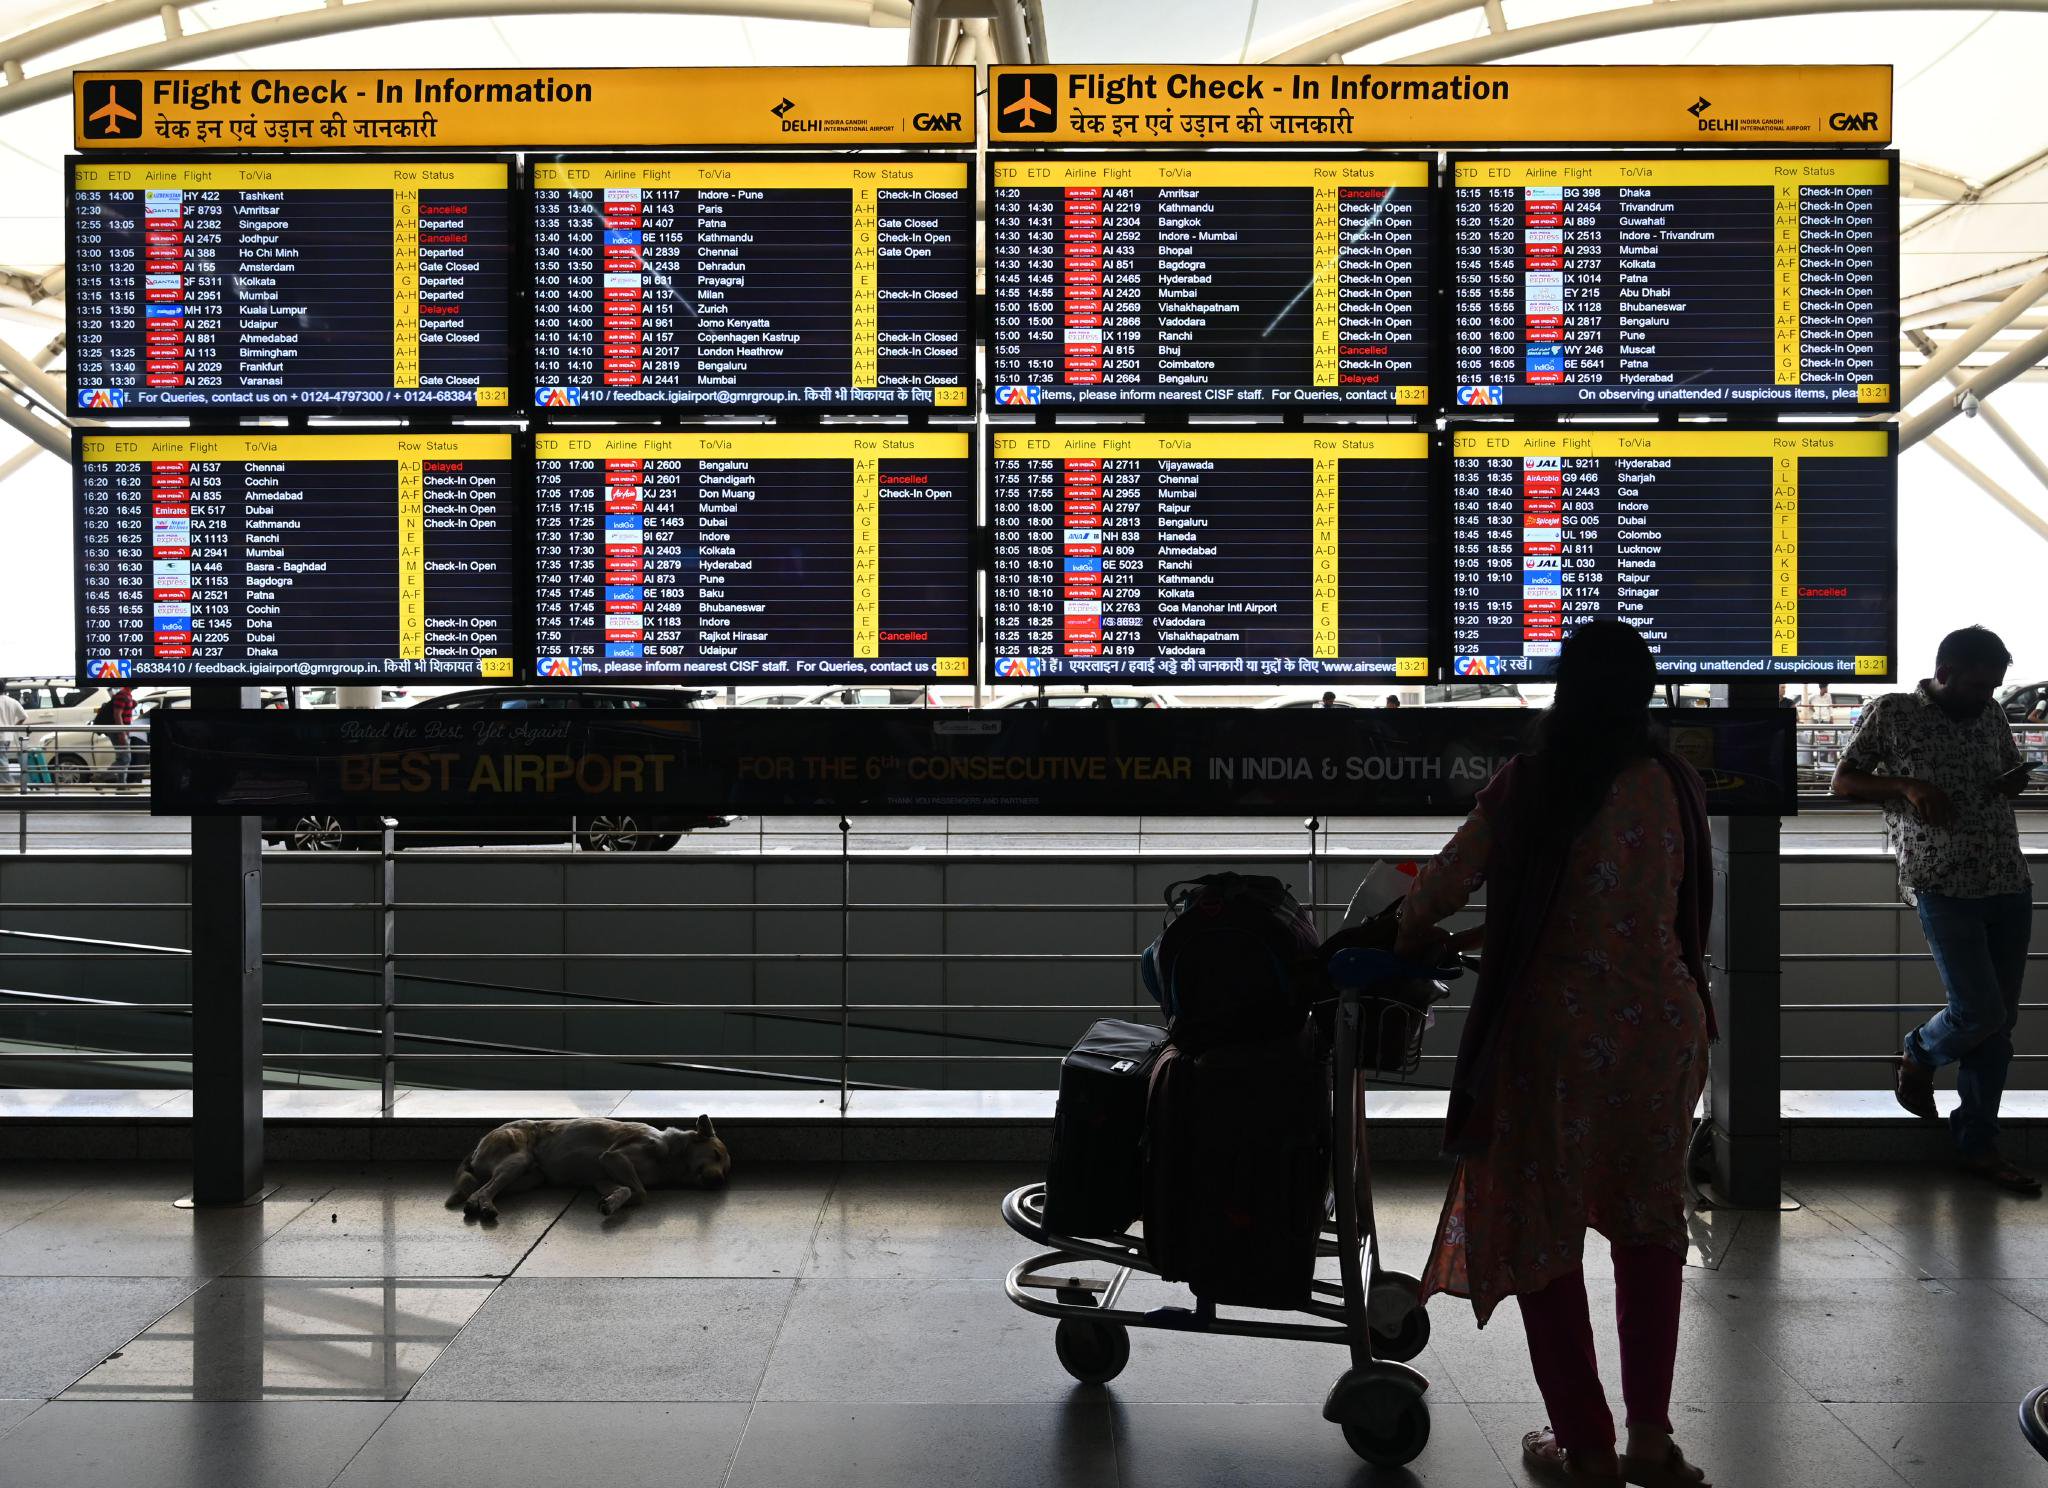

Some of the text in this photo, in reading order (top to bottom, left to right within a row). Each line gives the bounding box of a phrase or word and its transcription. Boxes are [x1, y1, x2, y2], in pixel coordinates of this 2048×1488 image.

[154, 80, 241, 110] Flight
[251, 79, 347, 104] Check
[377, 79, 402, 103] In
[415, 77, 591, 103] Information
[1069, 74, 1157, 104] Flight
[1167, 74, 1263, 99] Check
[1293, 75, 1319, 99] In
[1332, 74, 1508, 100] Information
[155, 111, 438, 143] चेक इन एवं उड़ान की जानकारी
[782, 120, 822, 132] DELHI
[1070, 107, 1354, 138] चेक इन एवं उड़ान की जानकारी
[1699, 119, 1738, 131] DELHI
[75, 170, 454, 182] STD ETD Airline Flight To/Via Row Status
[76, 191, 416, 200] 06:35 14:00 HY 422 Tashkent H-N
[698, 191, 763, 199] Indore Pune
[239, 205, 467, 214] Amritsar Cancelled
[995, 203, 1335, 212] 14:30 14:30 AI 2219 Kathmandu A-H
[1619, 203, 1674, 211] Trivandrum
[240, 306, 307, 318] Kuala Lumpur
[1158, 303, 1411, 314] Vishakhapatnam Check-In Open
[535, 319, 874, 329] 14:00 14:00 AI 961 Jomo Kenyatta A-H
[698, 333, 957, 344] Copenhagen Kastrup Check-In Closed
[1457, 344, 1791, 354] 16:00 16:00 WY 246 Muscat K
[1080, 389, 1234, 402] please inform nearest CISF
[1579, 388, 1791, 401] On observing unattended suspicious
[995, 460, 1334, 471] 17:55 17:55 AI 2711 Vijayawada A-F
[1562, 458, 1572, 468] JL
[1576, 459, 1599, 468] 9211
[1618, 459, 1671, 470] Hyderabad
[699, 475, 927, 486] Chandigarh Cancelled
[1455, 473, 1479, 481] 18:35
[1488, 473, 1512, 481] 18:35
[1562, 473, 1577, 482] G9
[1580, 473, 1598, 482] 466
[1618, 473, 1655, 484] Sharjah
[537, 489, 868, 500] 17:05 17:05 XJ 231 Don Muang J
[117, 506, 141, 514] 16:45
[191, 506, 205, 514] EK
[208, 506, 225, 514] 517
[246, 506, 273, 514] Dubai
[401, 505, 420, 513] J-M
[247, 561, 496, 573] Basra Baghdad Check-In Open
[247, 577, 292, 587] Bagdogra
[1618, 587, 1847, 598] Srinagar Cancelled
[1158, 603, 1277, 614] Goa Manohar Intl Airport
[700, 631, 768, 642] Rajkot Hirasar
[340, 720, 393, 739] Rated
[392, 720, 417, 739] the
[472, 720, 504, 746] Yet
[510, 720, 571, 746] Again!
[340, 752, 676, 794] BEST AIRPORT
[736, 755, 796, 781] FOR
[801, 755, 858, 781] THE
[907, 756, 1106, 780] CONSECUTIVE
[1115, 756, 1193, 780] YEAR
[1208, 756, 1234, 780] IN
[1242, 756, 1313, 780] INDIA
[1320, 756, 1338, 780] &
[1345, 756, 1441, 781] SOUTH
